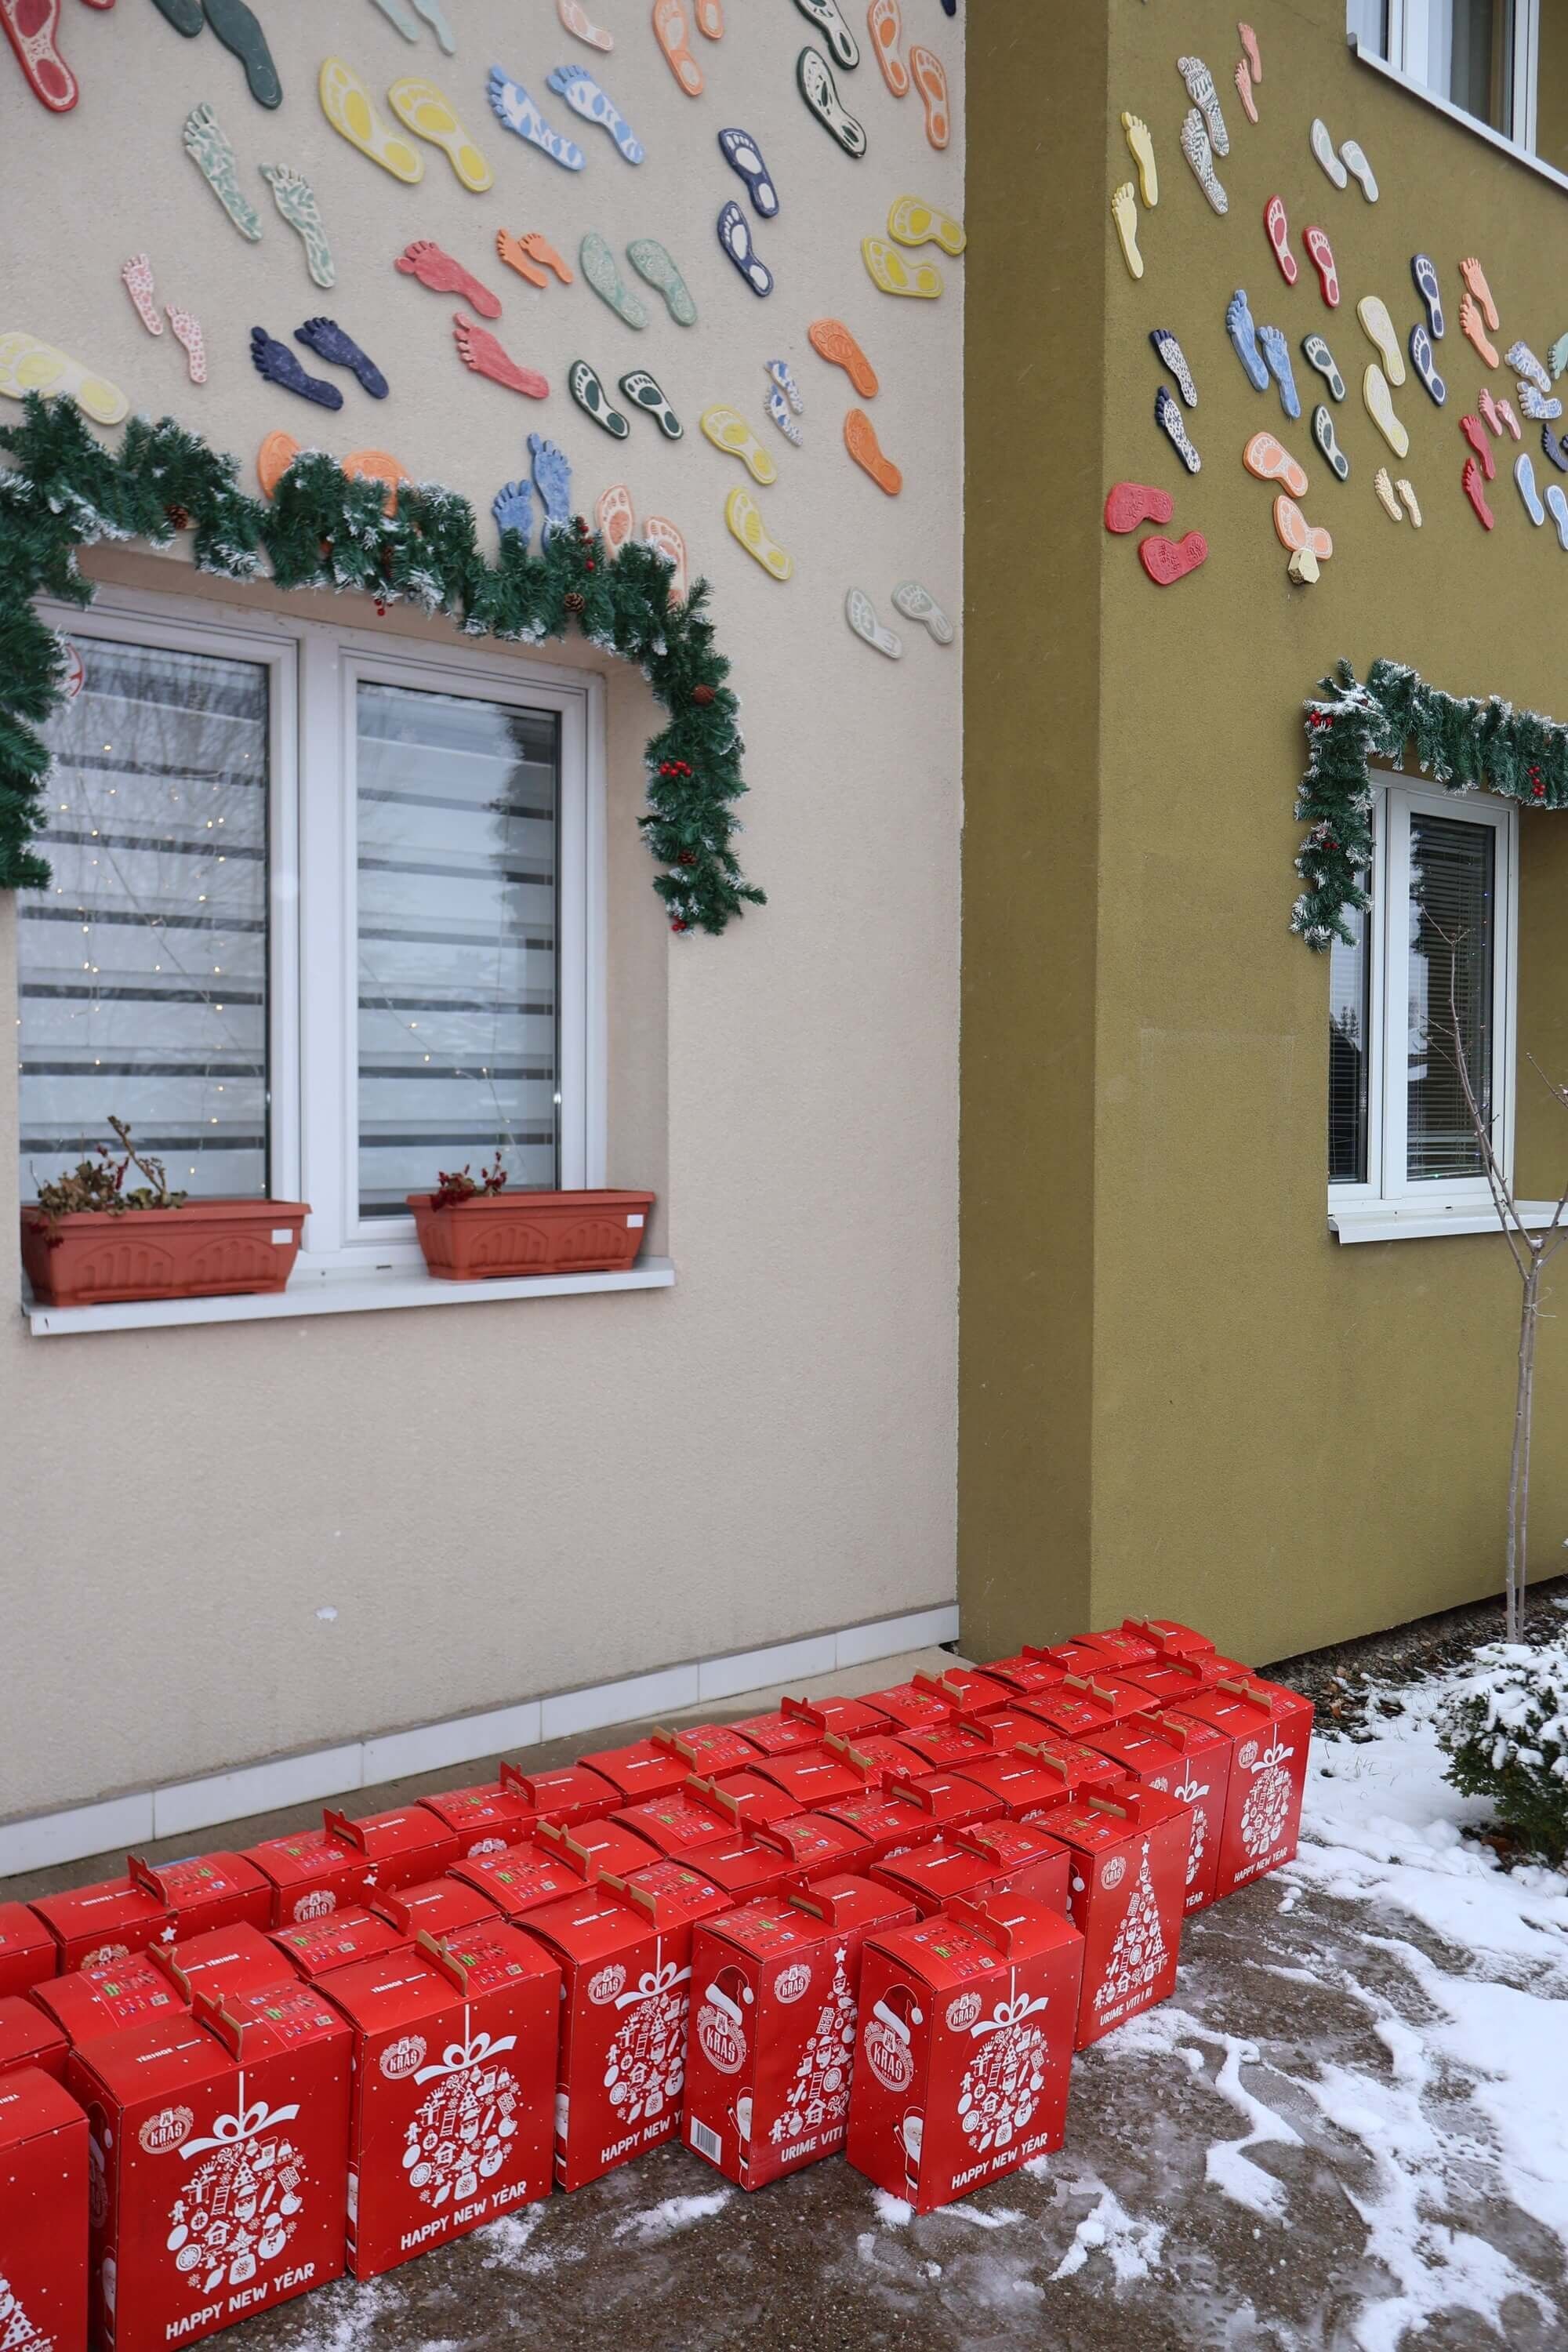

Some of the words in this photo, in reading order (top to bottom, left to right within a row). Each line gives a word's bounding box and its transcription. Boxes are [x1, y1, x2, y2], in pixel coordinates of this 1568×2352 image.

[1234, 1864, 1256, 1883] HAPPY
[1256, 1856, 1272, 1871] NEW
[1272, 1847, 1287, 1862] YEAR
[1185, 1891, 1203, 1907] YEAR
[1099, 2003, 1124, 2026] URIME
[1126, 1994, 1140, 2011] VITI
[601, 2131, 641, 2164] HAPPY
[644, 2115, 670, 2141] NEW
[781, 2136, 818, 2162] URIME
[821, 2125, 843, 2145] VITI
[952, 2160, 989, 2190] HAPPY
[992, 2147, 1018, 2171] NEW
[1021, 2132, 1048, 2156] YEAR
[401, 2216, 449, 2251] HAPPY
[453, 2198, 488, 2226] NEW
[492, 2180, 527, 2207] YEAR
[165, 2301, 223, 2340] HAPPY
[228, 2282, 268, 2313] NEW
[273, 2263, 315, 2292] YEAR
